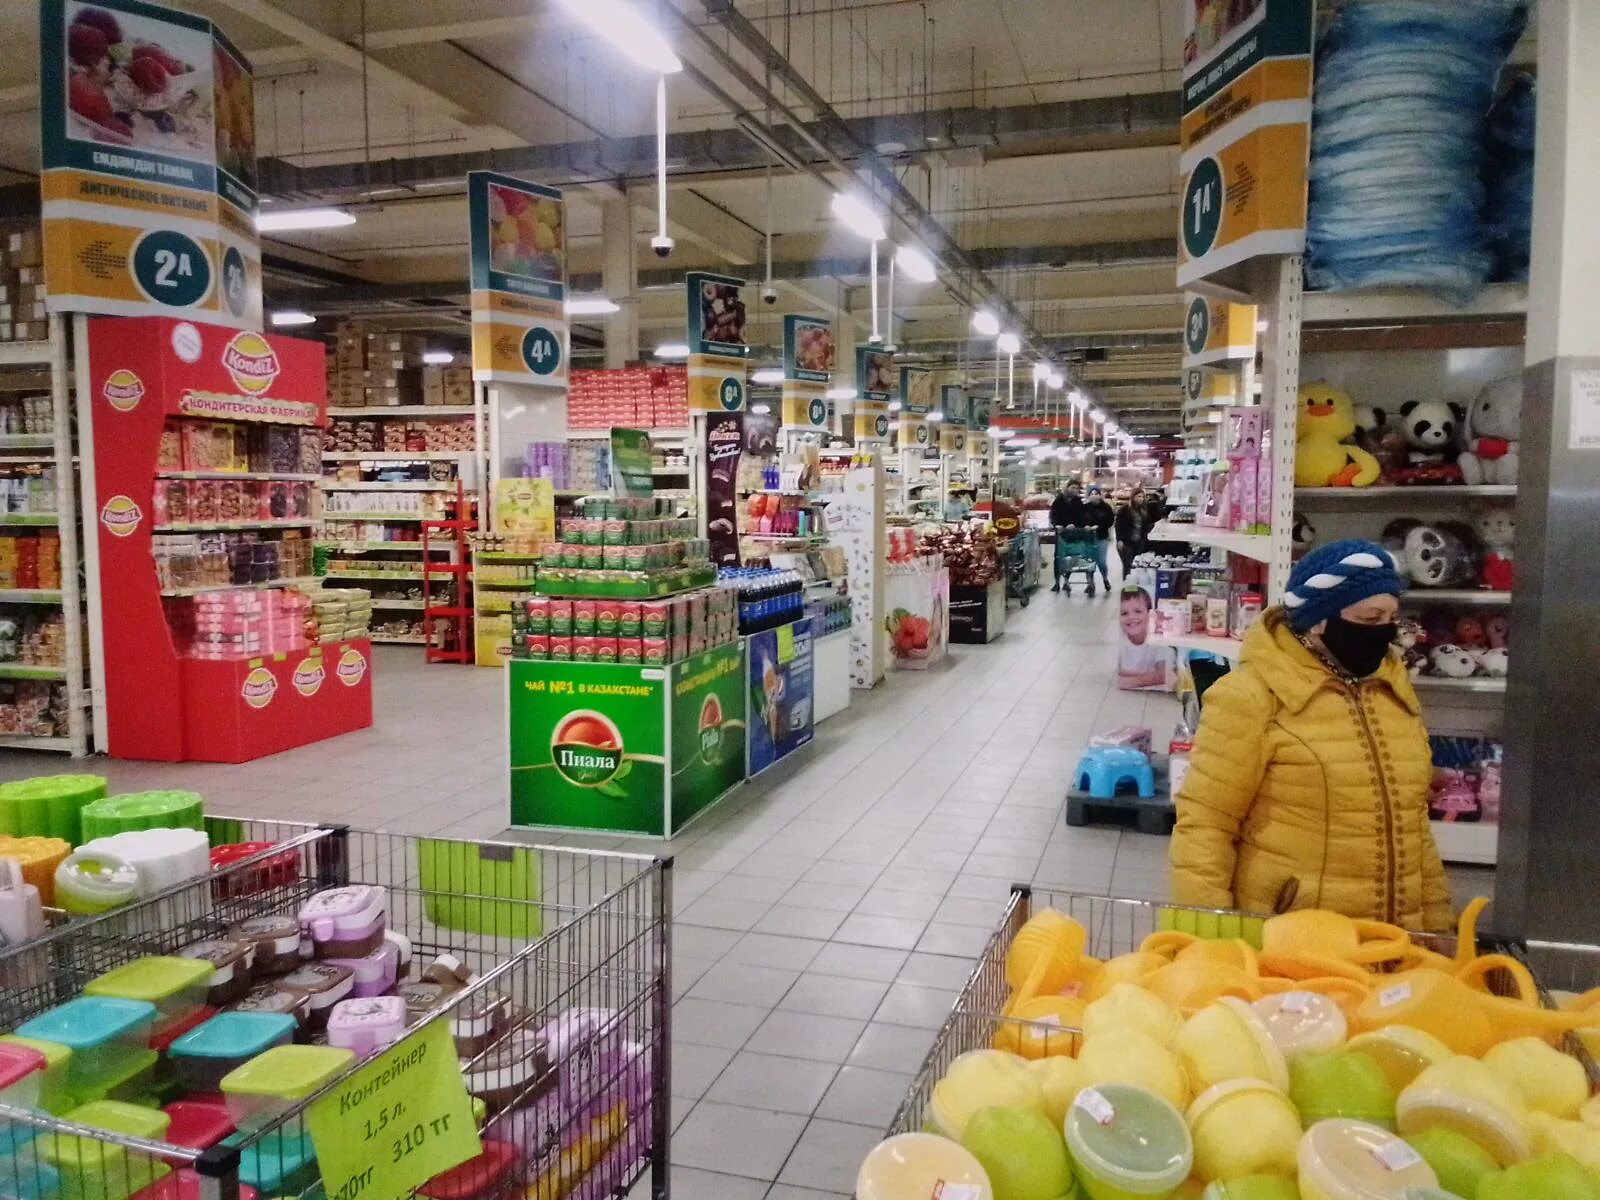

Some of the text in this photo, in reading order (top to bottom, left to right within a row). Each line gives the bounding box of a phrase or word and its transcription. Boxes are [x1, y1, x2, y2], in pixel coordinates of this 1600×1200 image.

[189, 398, 315, 419] КОНДИТЕРСКАЯ ФАБРИКА
[525, 681, 546, 692] ЧАЙ
[549, 680, 575, 695] №1
[578, 683, 586, 693] В
[560, 750, 616, 770] Пиала
[339, 1041, 428, 1116] Контейнер
[363, 1101, 407, 1142] 1,5 л.
[392, 1113, 451, 1164] 310 тг
